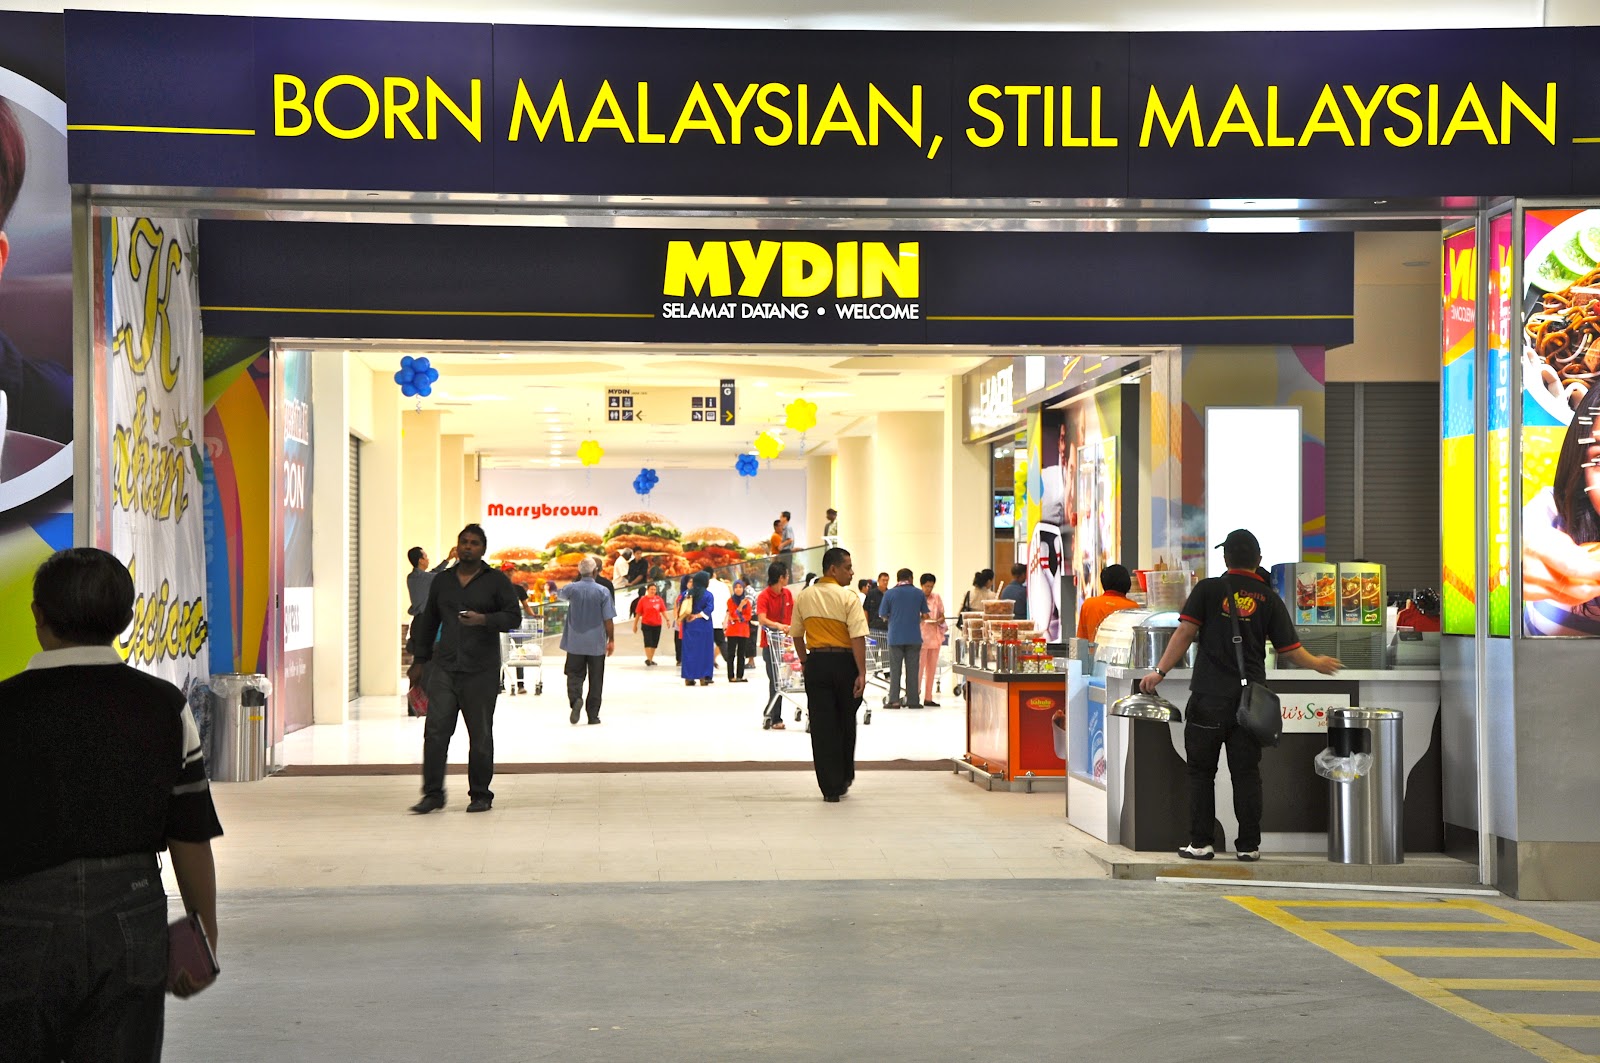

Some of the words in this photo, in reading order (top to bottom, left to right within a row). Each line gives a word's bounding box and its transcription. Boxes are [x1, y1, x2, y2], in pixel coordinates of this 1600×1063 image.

[272, 73, 483, 143] BORN
[508, 77, 943, 160] MALAYSIAN,
[965, 84, 1118, 148] STILL
[1138, 80, 1558, 148] MALAYSIAN
[663, 239, 920, 299] MYDIN
[662, 302, 738, 320] SELAMAT
[741, 302, 809, 320] DATANG
[835, 303, 920, 320] WELCOME
[488, 503, 599, 519] Marrybrown
